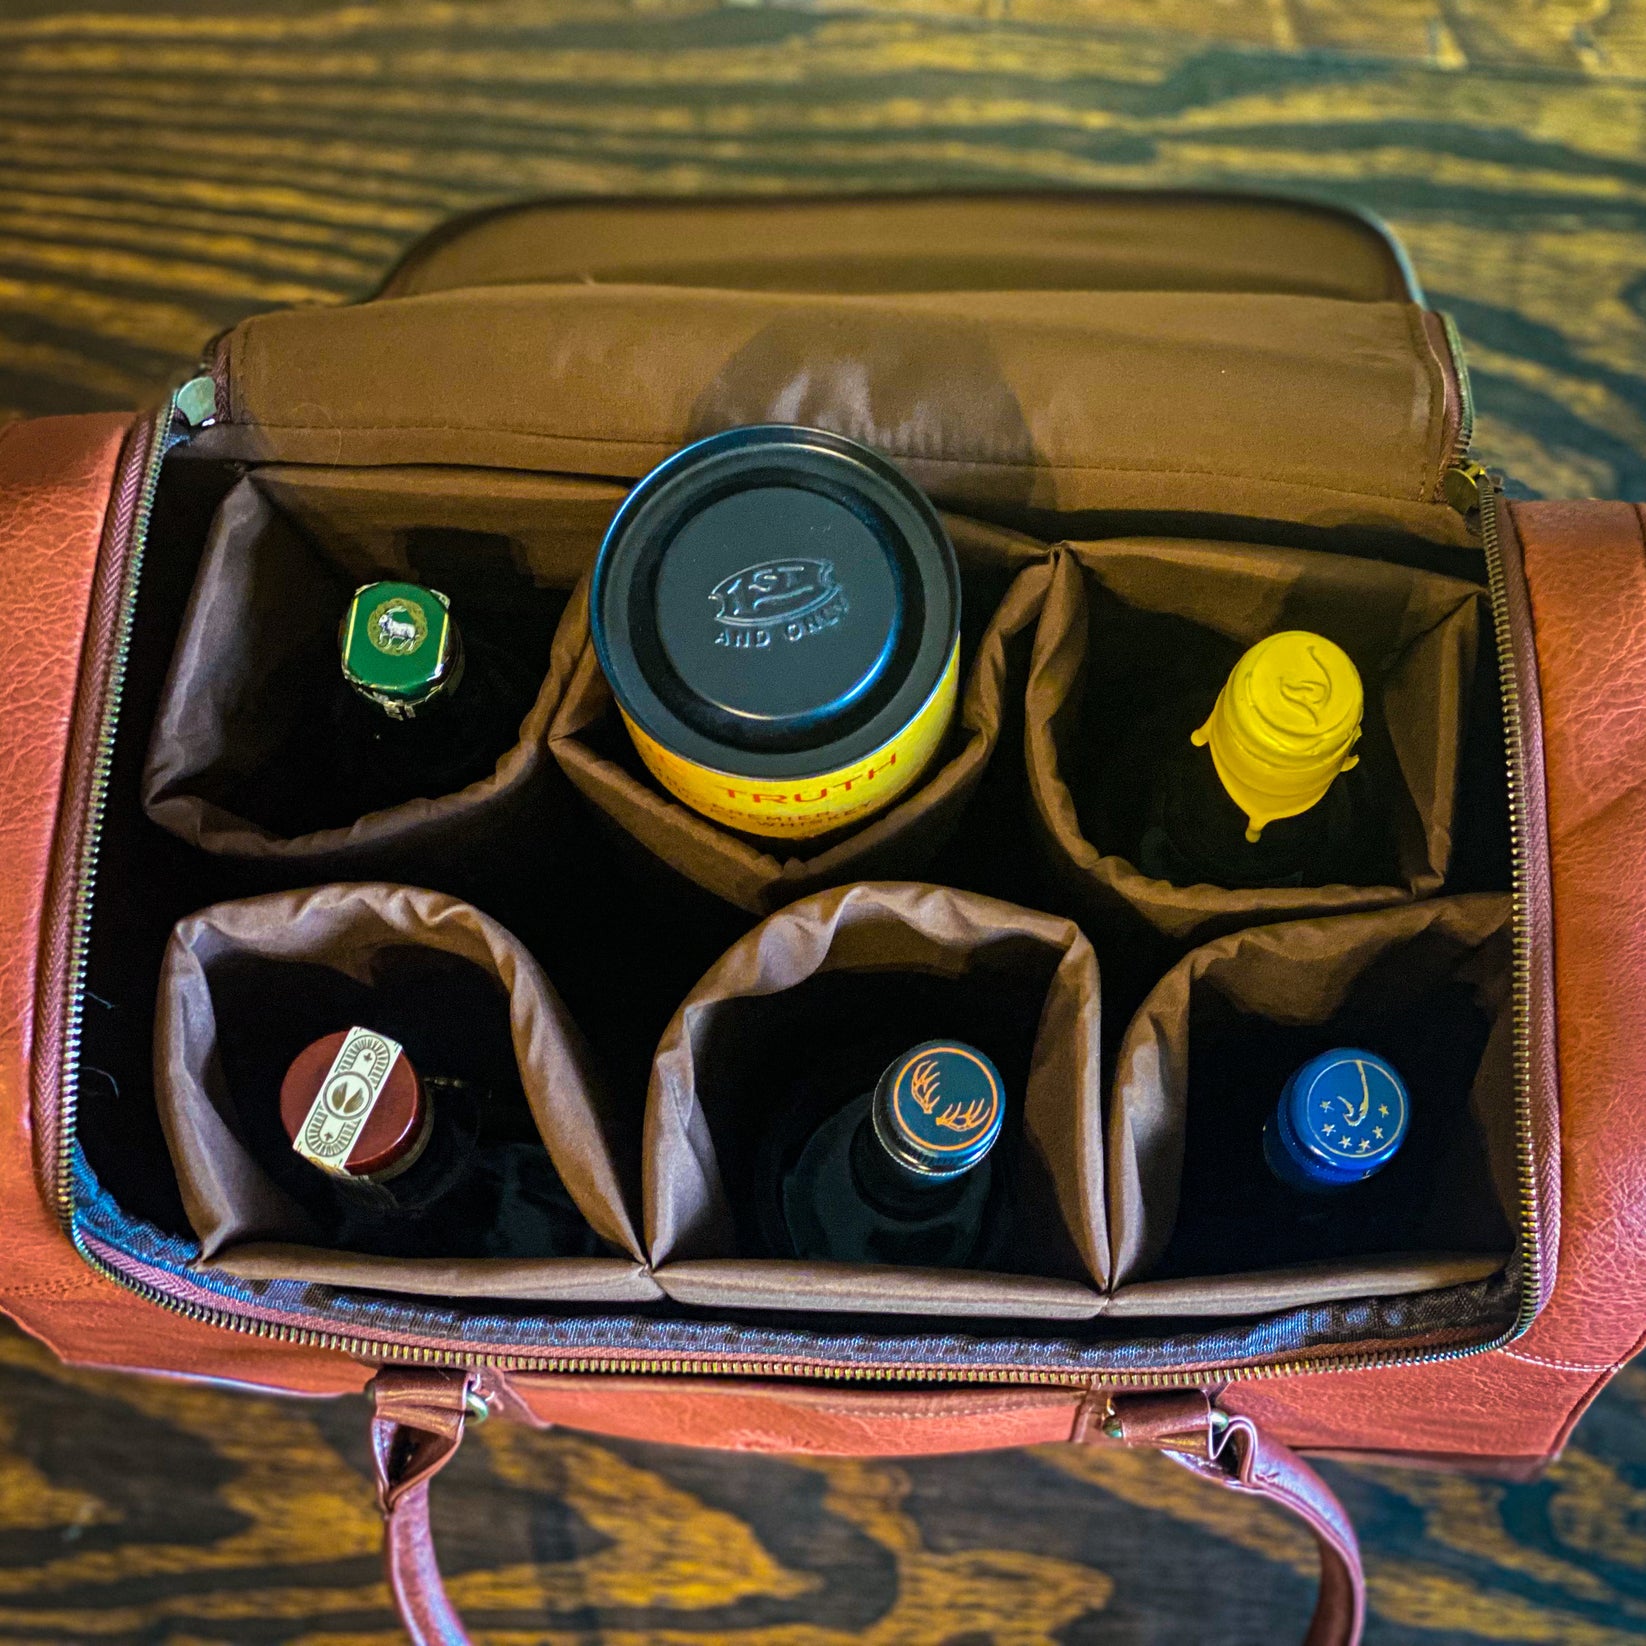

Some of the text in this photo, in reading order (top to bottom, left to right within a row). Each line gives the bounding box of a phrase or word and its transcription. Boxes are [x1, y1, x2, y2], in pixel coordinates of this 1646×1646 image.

[727, 567, 805, 616] 1ST
[714, 627, 771, 648] AND
[714, 752, 897, 804] TRUTH
